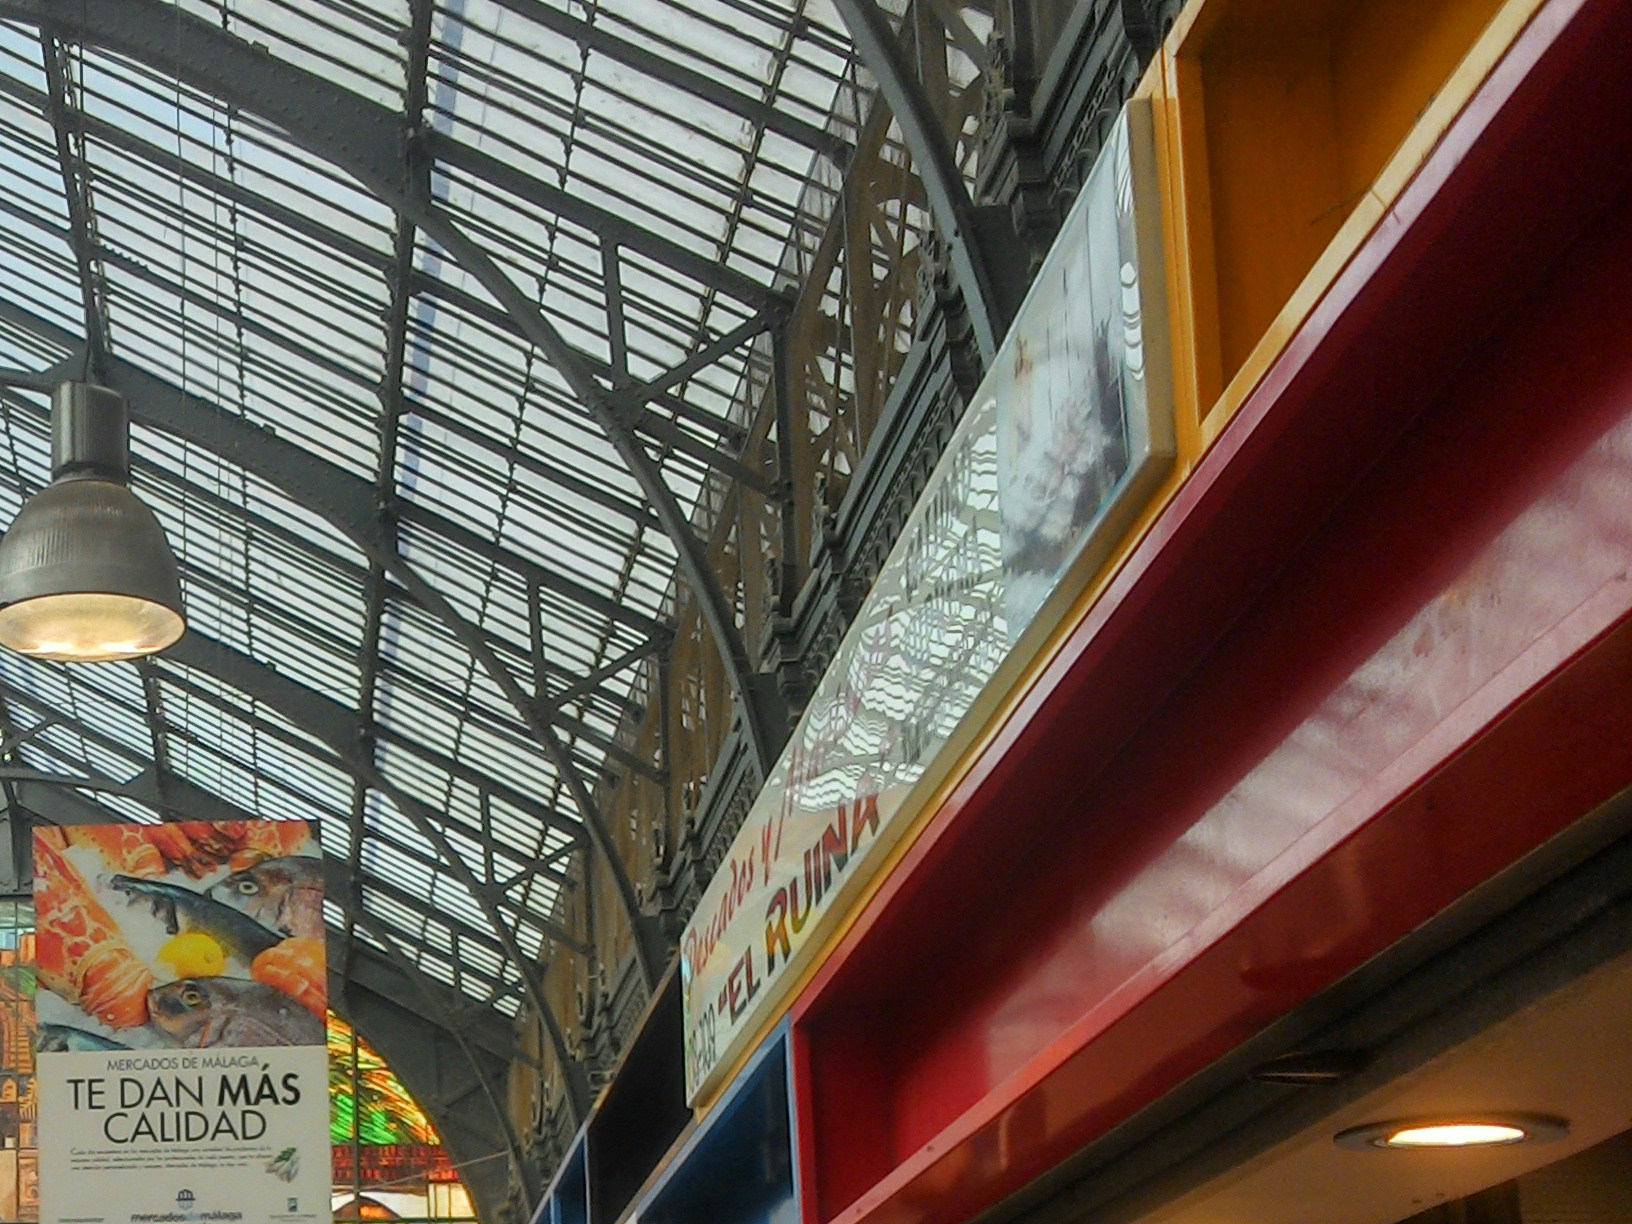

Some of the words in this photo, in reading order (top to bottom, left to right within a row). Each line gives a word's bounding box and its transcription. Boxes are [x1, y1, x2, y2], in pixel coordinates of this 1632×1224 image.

[107, 1057, 178, 1071] MERCADOS
[182, 1056, 199, 1069] DE
[67, 1078, 105, 1110] TE
[120, 1076, 204, 1109] DAN
[218, 1064, 301, 1106] MÁS
[103, 1109, 267, 1143] CALIDAD
